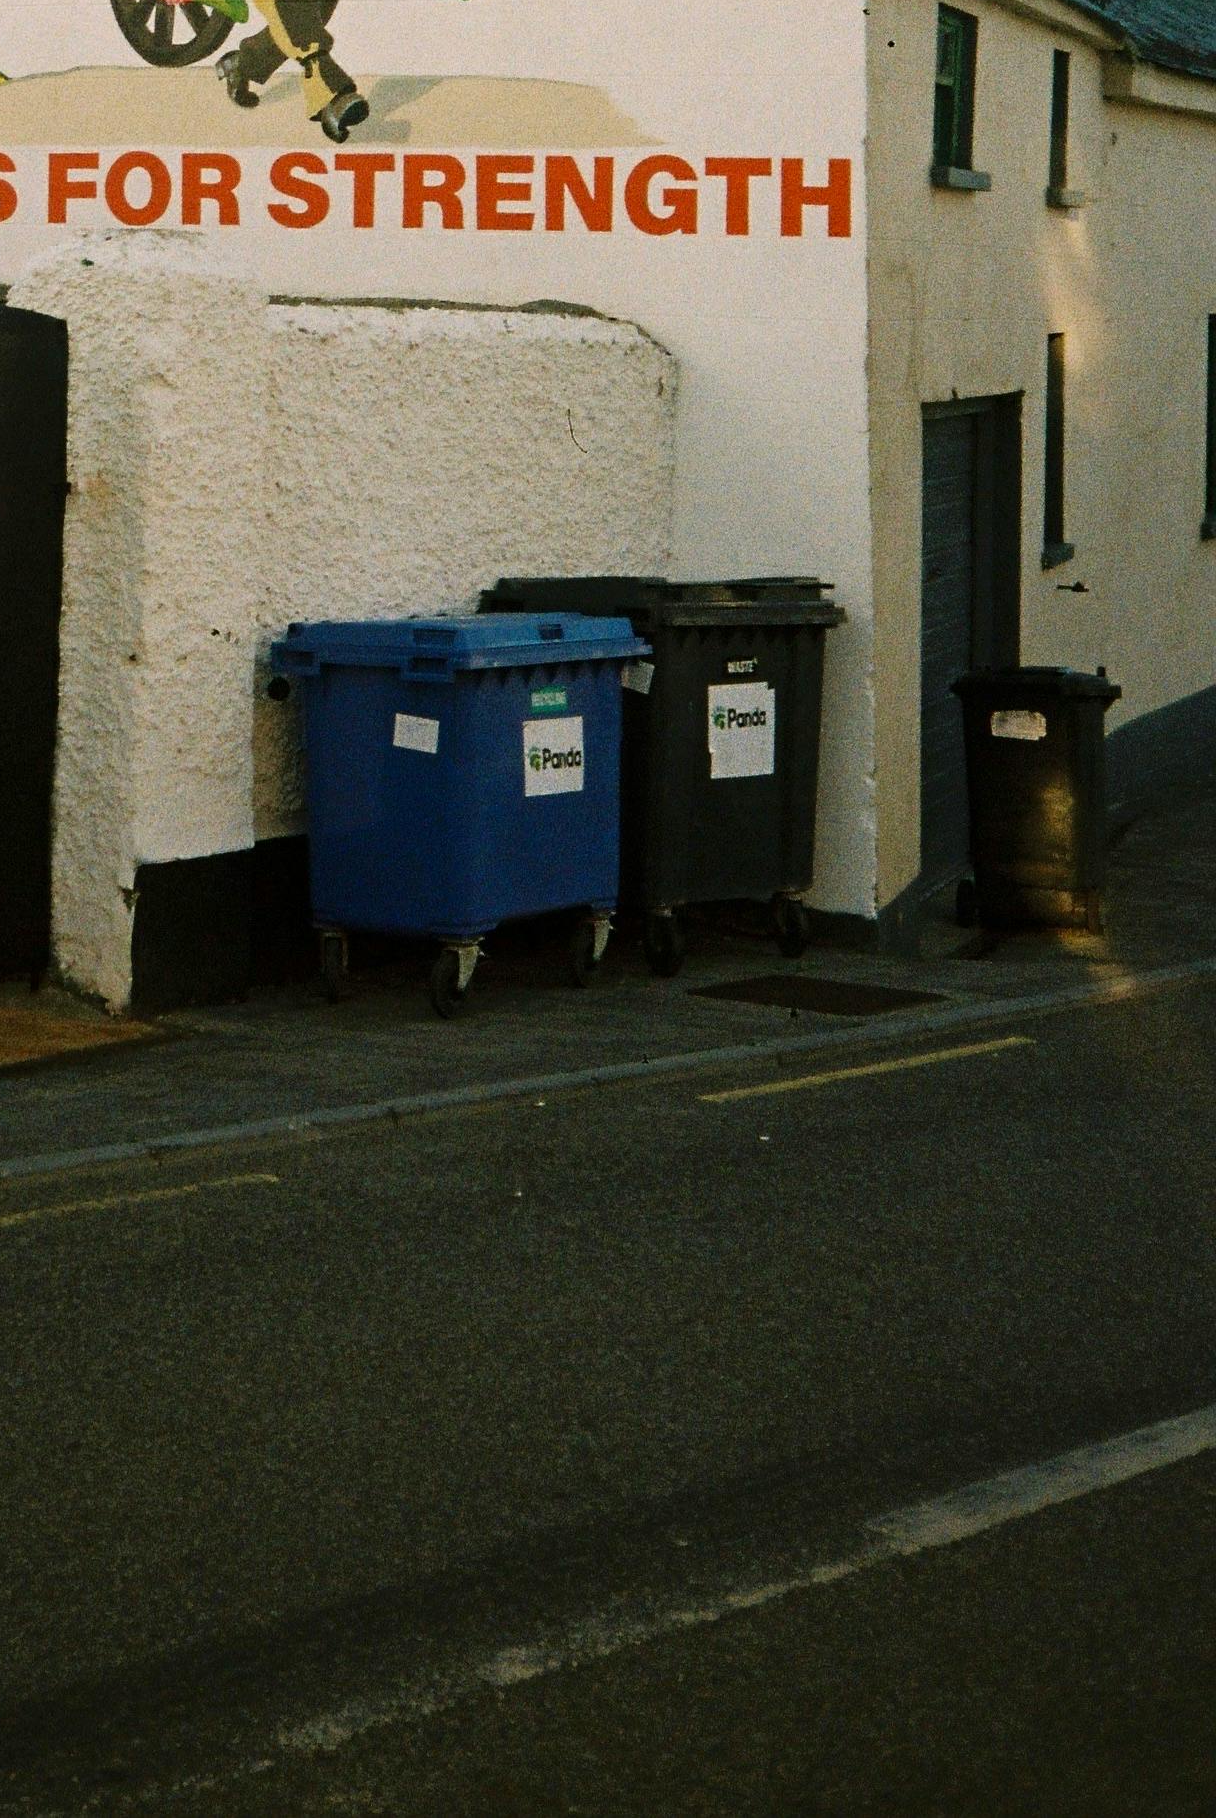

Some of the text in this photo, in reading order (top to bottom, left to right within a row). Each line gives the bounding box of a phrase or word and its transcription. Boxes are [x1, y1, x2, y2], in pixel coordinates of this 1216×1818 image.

[46, 149, 243, 227] FOR
[266, 151, 853, 239] STRENGTH
[726, 707, 767, 729] Panda
[542, 746, 582, 771] Panda
